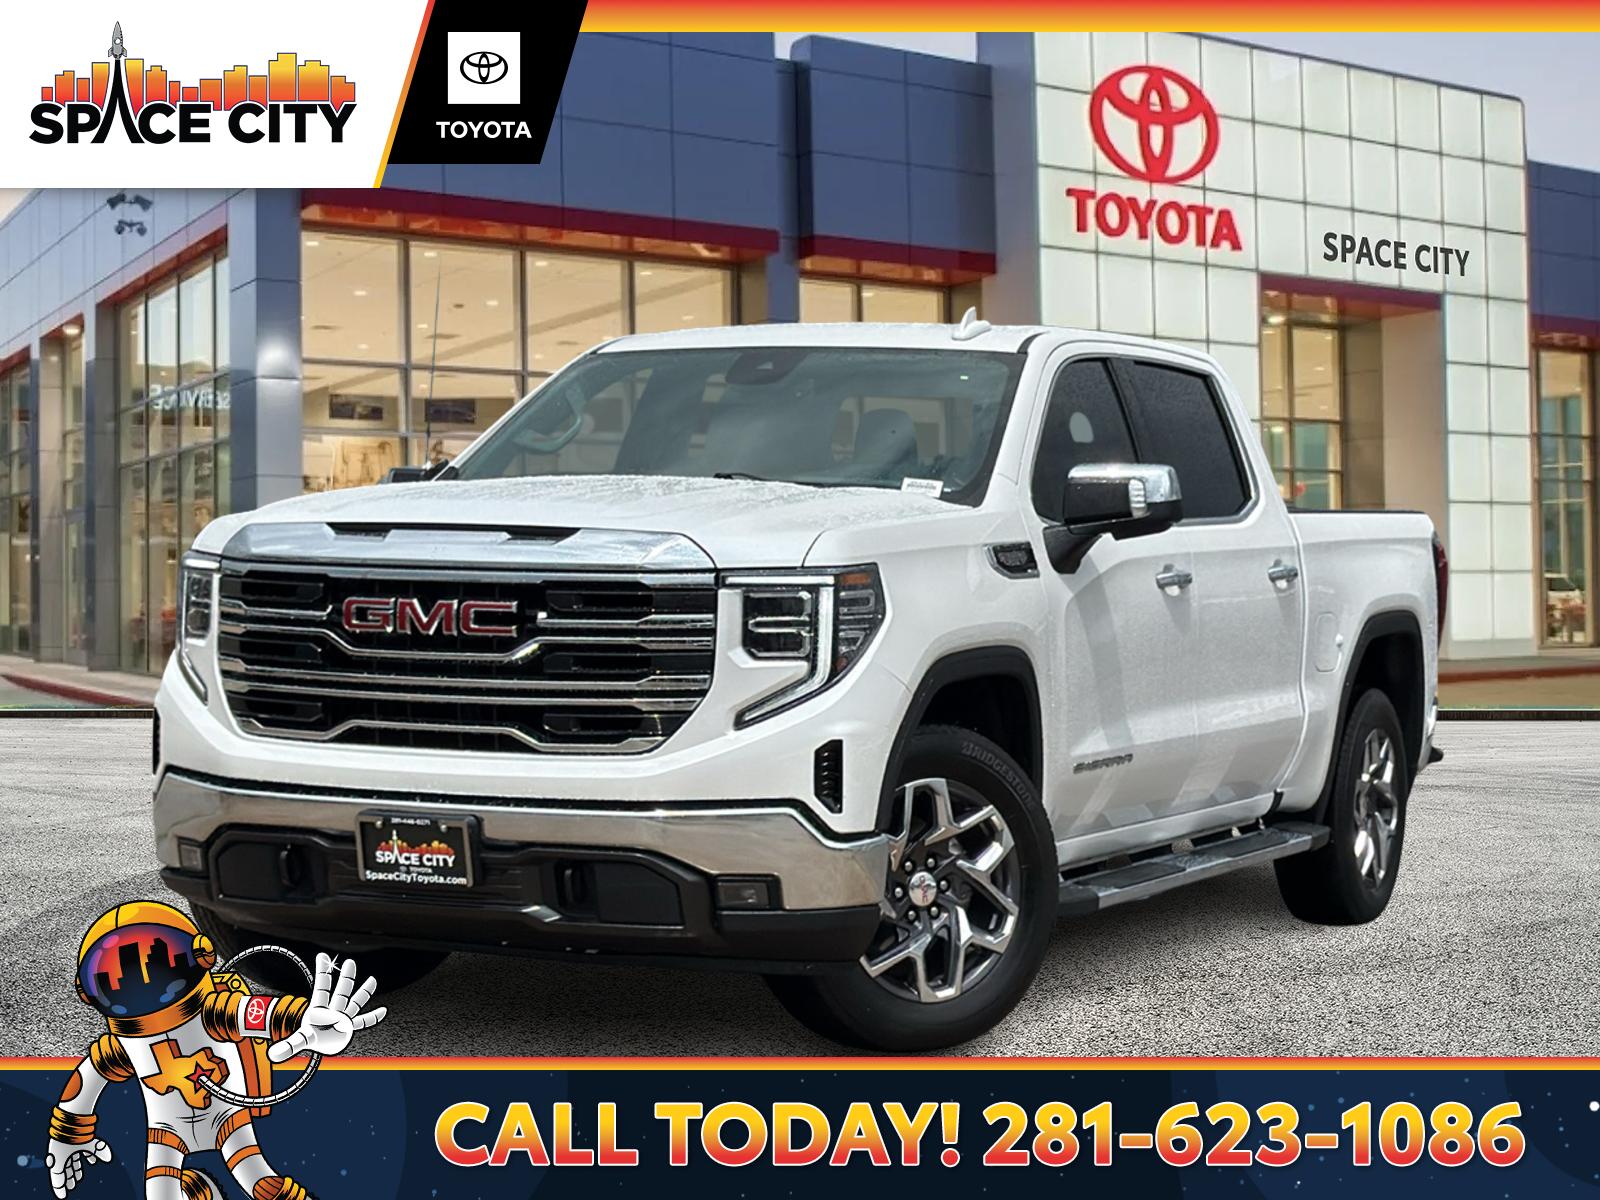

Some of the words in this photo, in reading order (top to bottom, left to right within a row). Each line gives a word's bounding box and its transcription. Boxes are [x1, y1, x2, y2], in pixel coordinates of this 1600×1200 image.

[1066, 187, 1242, 251] TOYOTA
[1323, 231, 1407, 270] SPACE
[1414, 244, 1470, 277] CITY
[342, 597, 518, 638] GMC
[365, 870, 468, 885] SpaceCityToyota.com
[422, 853, 456, 868] CITY
